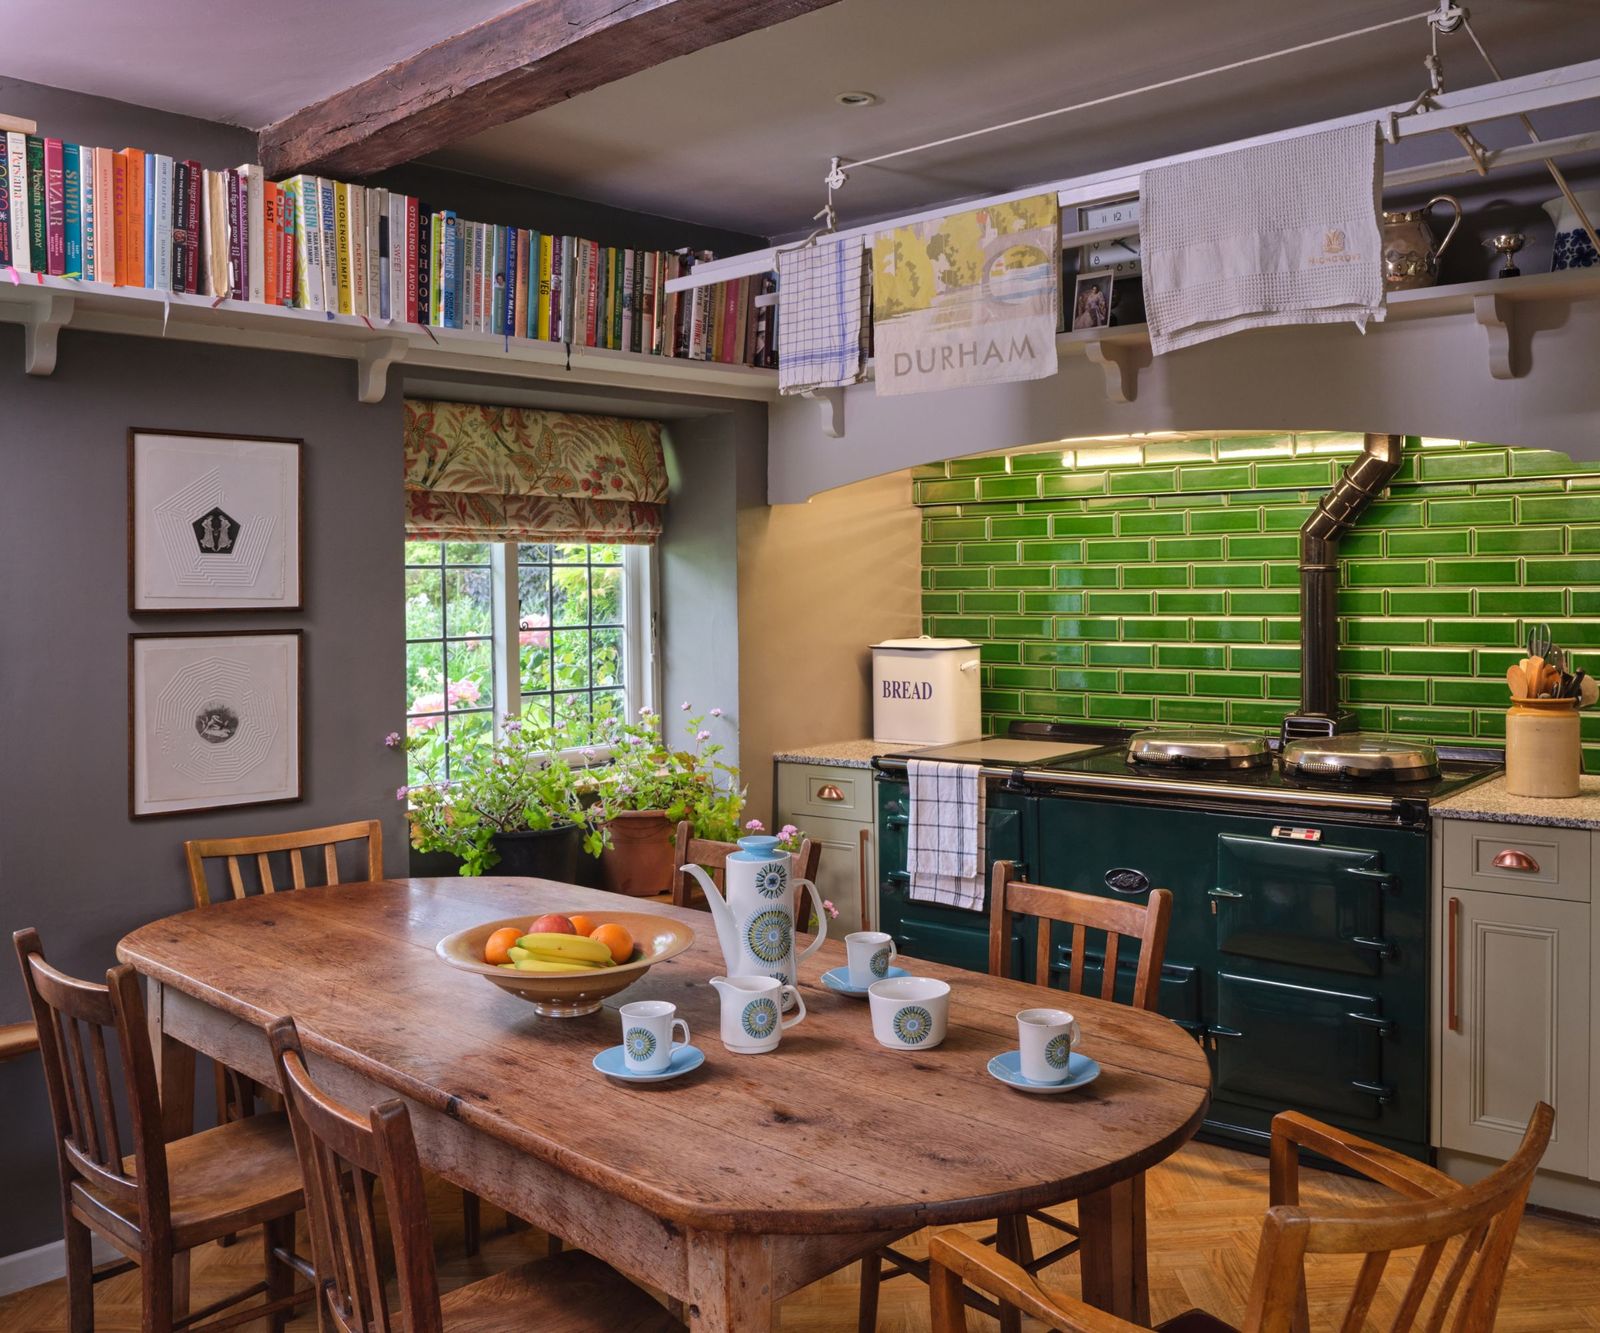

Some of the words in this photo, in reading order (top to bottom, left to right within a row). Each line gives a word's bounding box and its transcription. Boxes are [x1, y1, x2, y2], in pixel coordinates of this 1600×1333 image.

[12, 151, 24, 199] Persiana
[33, 169, 43, 206] Persiana
[191, 167, 199, 179] salt
[49, 168, 63, 226] BAZAAR
[65, 170, 79, 224] SIMPLY
[116, 168, 124, 216] MEZCLA
[188, 181, 198, 203] sugar
[230, 193, 239, 206] figs
[303, 182, 317, 228] FALASTIN
[322, 187, 334, 232] JERUSALEM
[34, 209, 42, 248] EVERYDAY
[189, 204, 197, 229] smoke
[231, 207, 239, 224] sugar
[266, 200, 274, 223] EAST
[339, 194, 347, 253] OTTOLENGHI
[1113, 212, 1122, 221] 12
[393, 244, 401, 273] SWEET
[419, 215, 428, 313] DISHOOM
[446, 227, 455, 279] MAANGCHI'S
[1094, 256, 1100, 264] 8
[340, 257, 348, 289] SIMPLE
[370, 248, 379, 299] PLENTY
[540, 280, 550, 295] VEG
[894, 334, 1036, 377] DURHAM
[882, 680, 933, 700] BREAD
